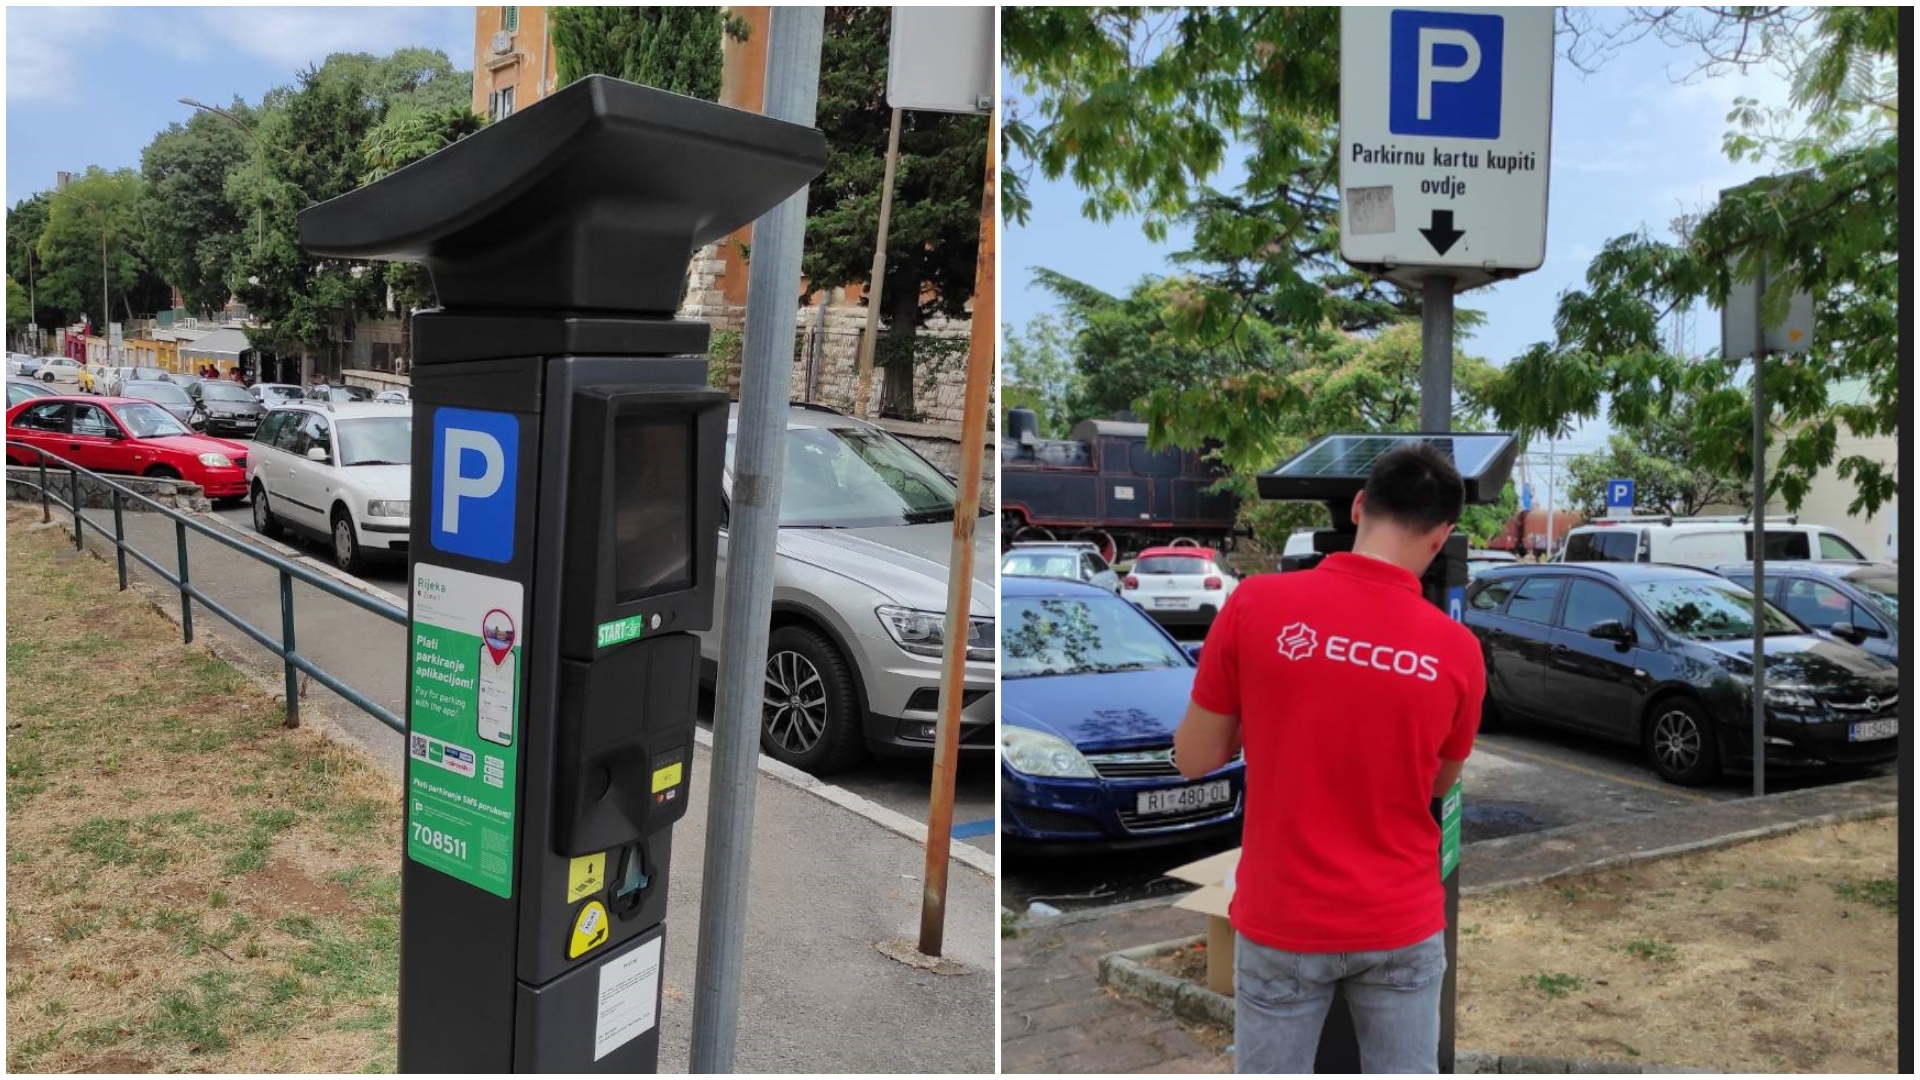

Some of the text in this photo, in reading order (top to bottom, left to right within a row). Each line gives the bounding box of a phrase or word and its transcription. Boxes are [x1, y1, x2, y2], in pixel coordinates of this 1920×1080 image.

[1417, 27, 1482, 121] P
[1352, 143, 1536, 174] Parkirnu kartu kupiti
[1421, 175, 1467, 200] ovdje
[442, 427, 505, 534] P
[1614, 484, 1628, 503] P
[417, 577, 446, 593] Rijeka
[416, 634, 439, 650] Plati
[598, 621, 627, 644] START
[416, 652, 465, 673] parkiranje
[1325, 636, 1439, 682] ECCOS
[416, 667, 474, 690] aplikacijom!
[415, 685, 466, 710] Pay for parking
[415, 698, 429, 708] with
[430, 702, 442, 713] the
[413, 777, 429, 789] Plati
[428, 785, 462, 802] parkiranje
[463, 795, 478, 807] SMS
[478, 802, 511, 819] porukom!
[1148, 795, 1164, 810] RI
[412, 821, 467, 860] 708511
